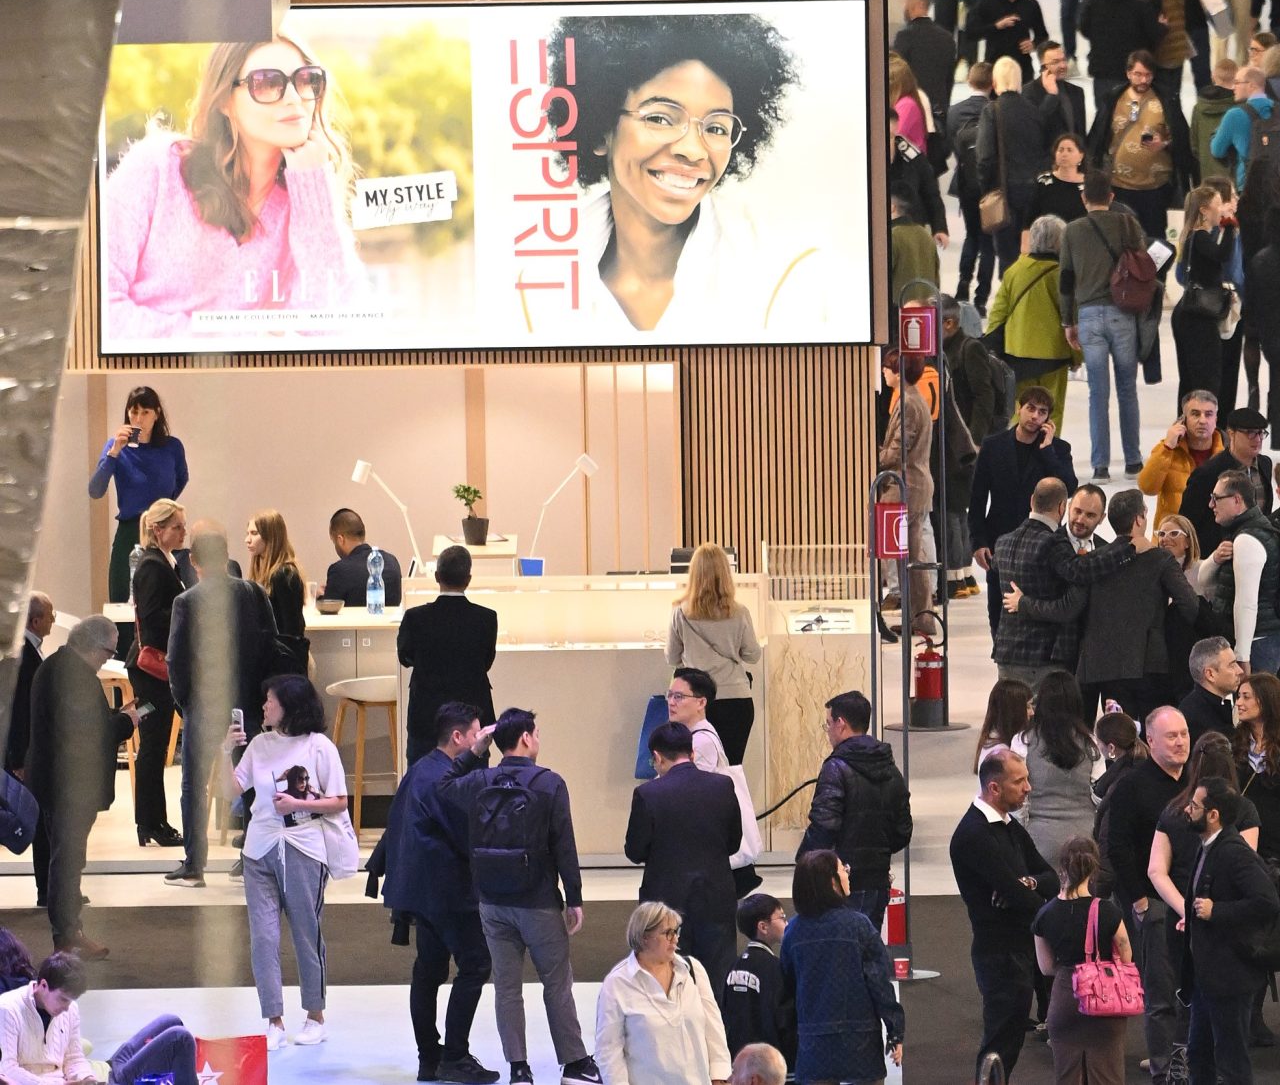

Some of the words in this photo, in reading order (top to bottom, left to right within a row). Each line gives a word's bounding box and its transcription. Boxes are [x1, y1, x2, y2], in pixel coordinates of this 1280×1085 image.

[365, 188, 388, 207] MY
[394, 182, 445, 204] STYLE
[509, 37, 579, 310] ESPRIT
